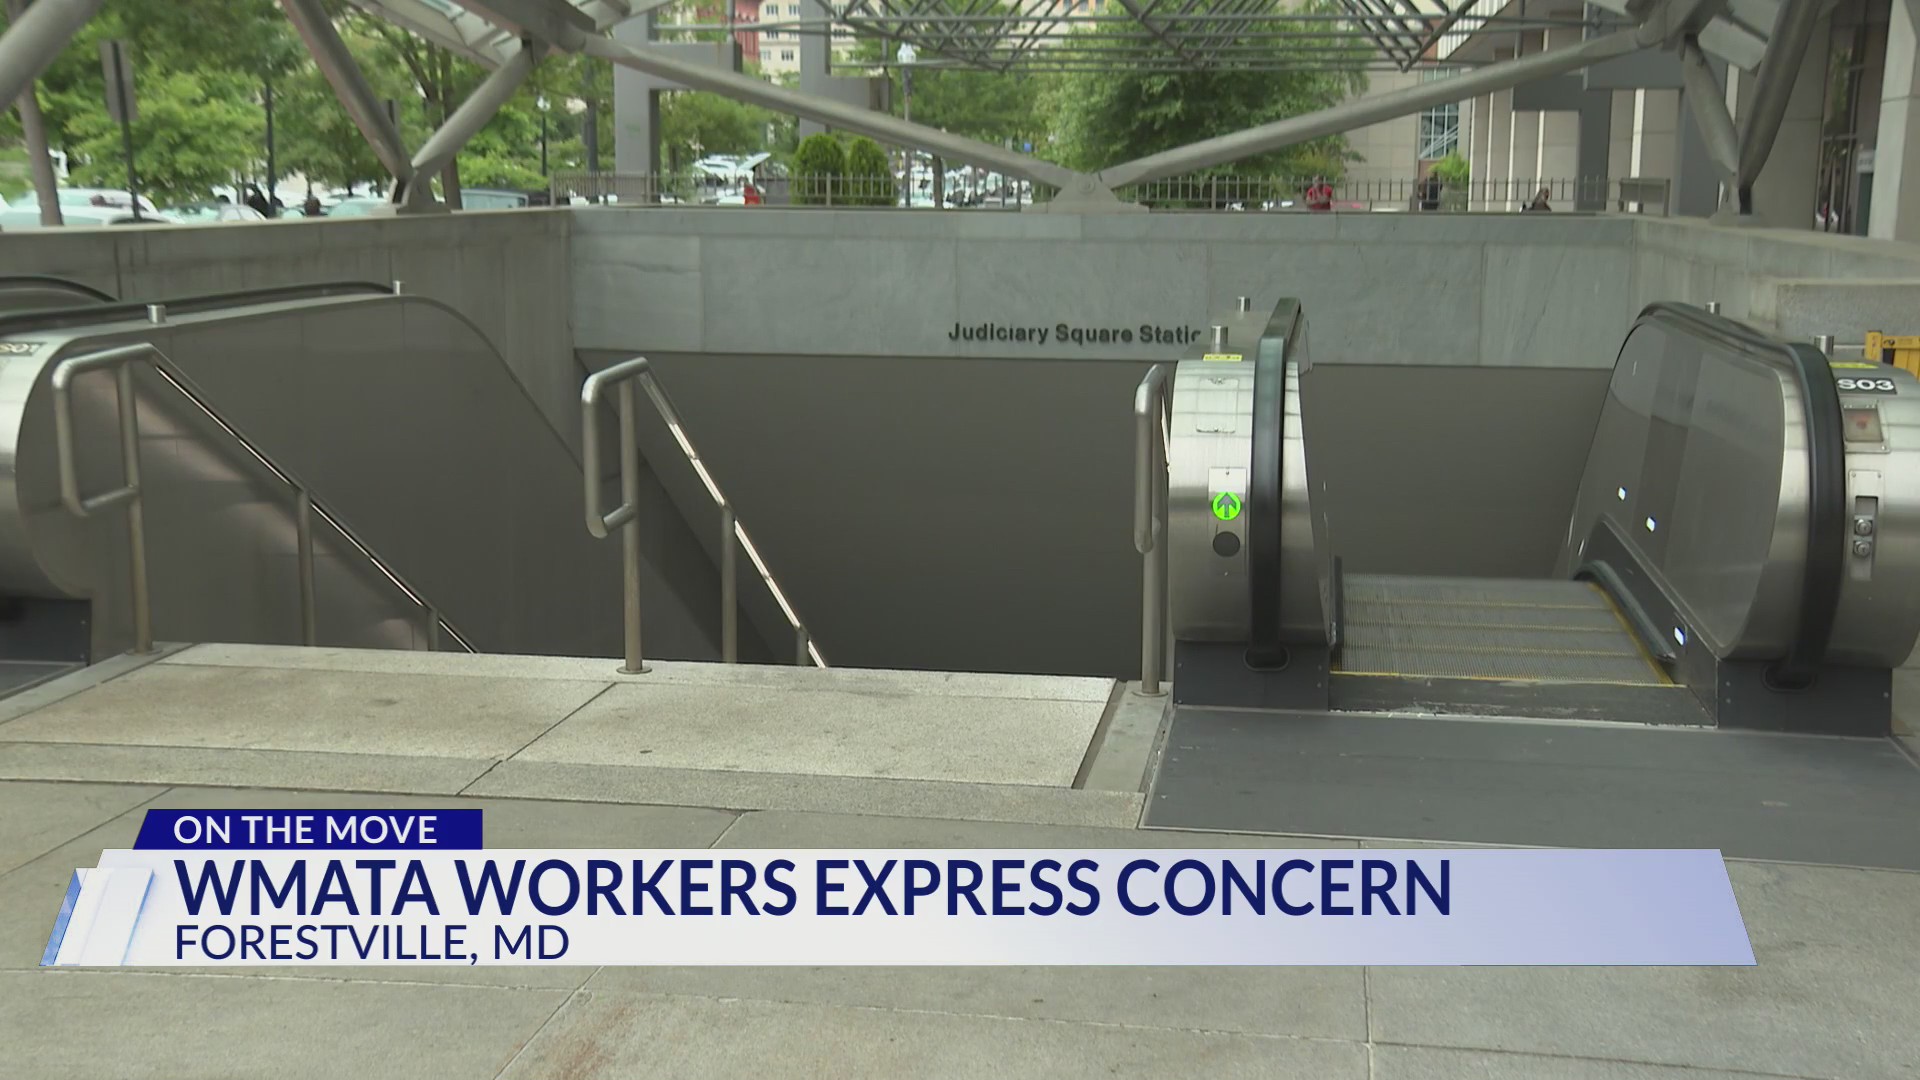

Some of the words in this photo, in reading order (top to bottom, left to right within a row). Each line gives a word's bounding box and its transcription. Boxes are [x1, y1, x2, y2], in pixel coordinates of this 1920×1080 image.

[948, 322, 1049, 345] Judiciary
[1055, 323, 1133, 346] Square
[1139, 324, 1201, 344] Statio
[1837, 378, 1895, 391] S03
